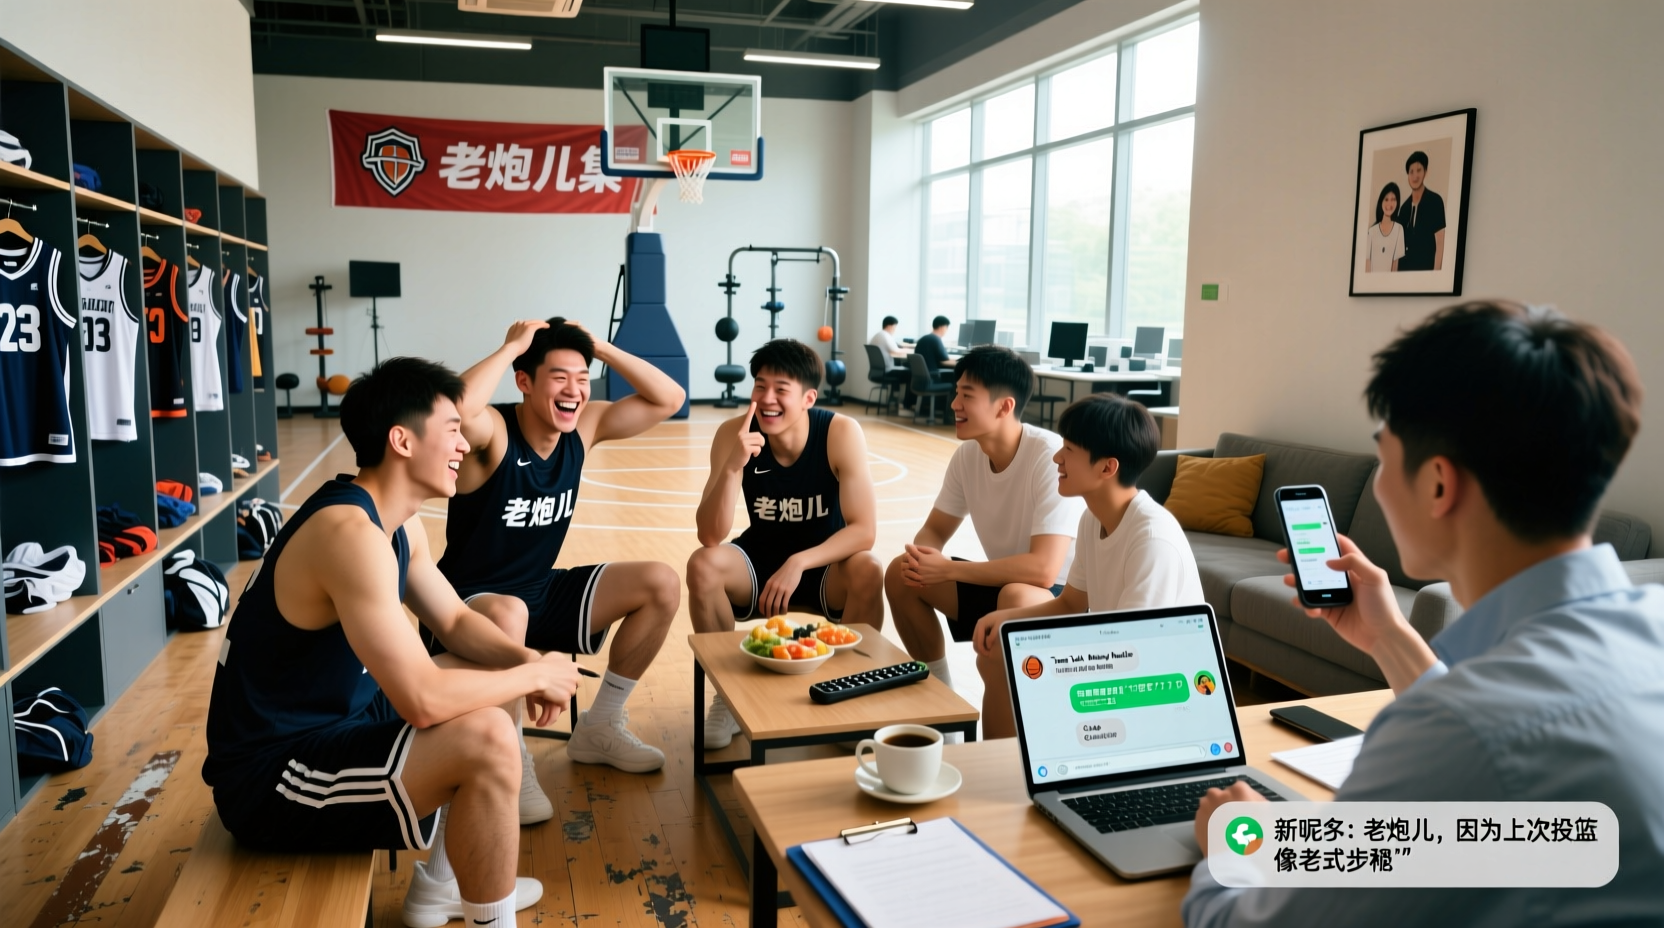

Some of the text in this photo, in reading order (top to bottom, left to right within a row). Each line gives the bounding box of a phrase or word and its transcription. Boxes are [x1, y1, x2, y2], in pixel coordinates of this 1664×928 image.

[0, 303, 41, 352] 23
[502, 488, 575, 528] 老炮儿
[752, 494, 829, 523] 老炮儿
